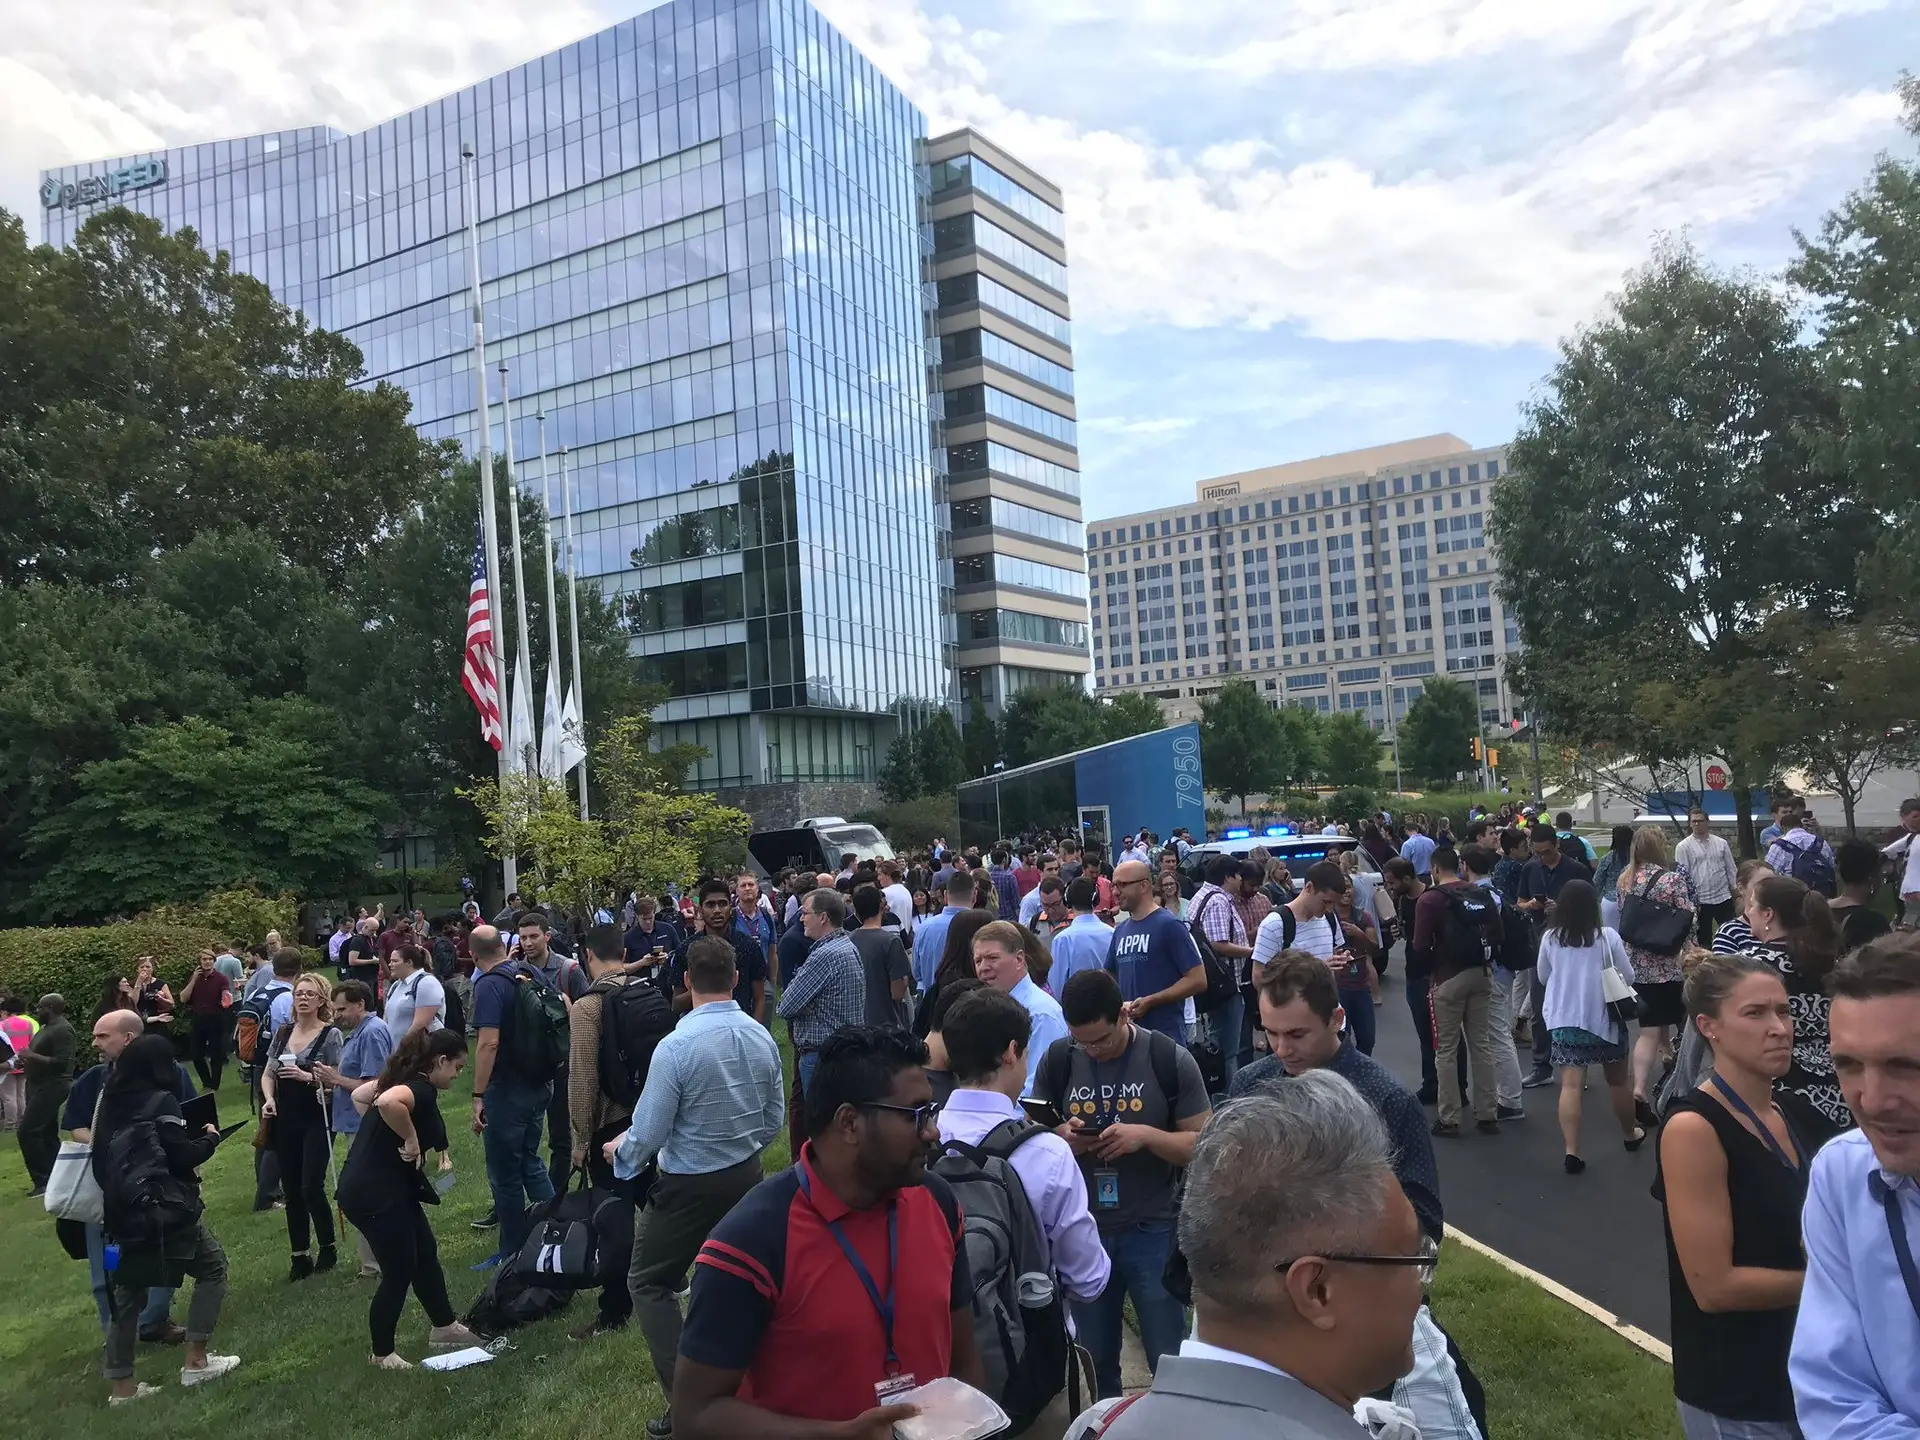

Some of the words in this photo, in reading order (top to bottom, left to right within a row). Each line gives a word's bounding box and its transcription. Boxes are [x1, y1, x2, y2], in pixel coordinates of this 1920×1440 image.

[1207, 487, 1237, 499] Hilton
[1172, 736, 1201, 809] 7950
[1707, 773, 1726, 784] STOP
[1116, 933, 1150, 956] APPN
[1069, 1083, 1144, 1101] ACADMY
